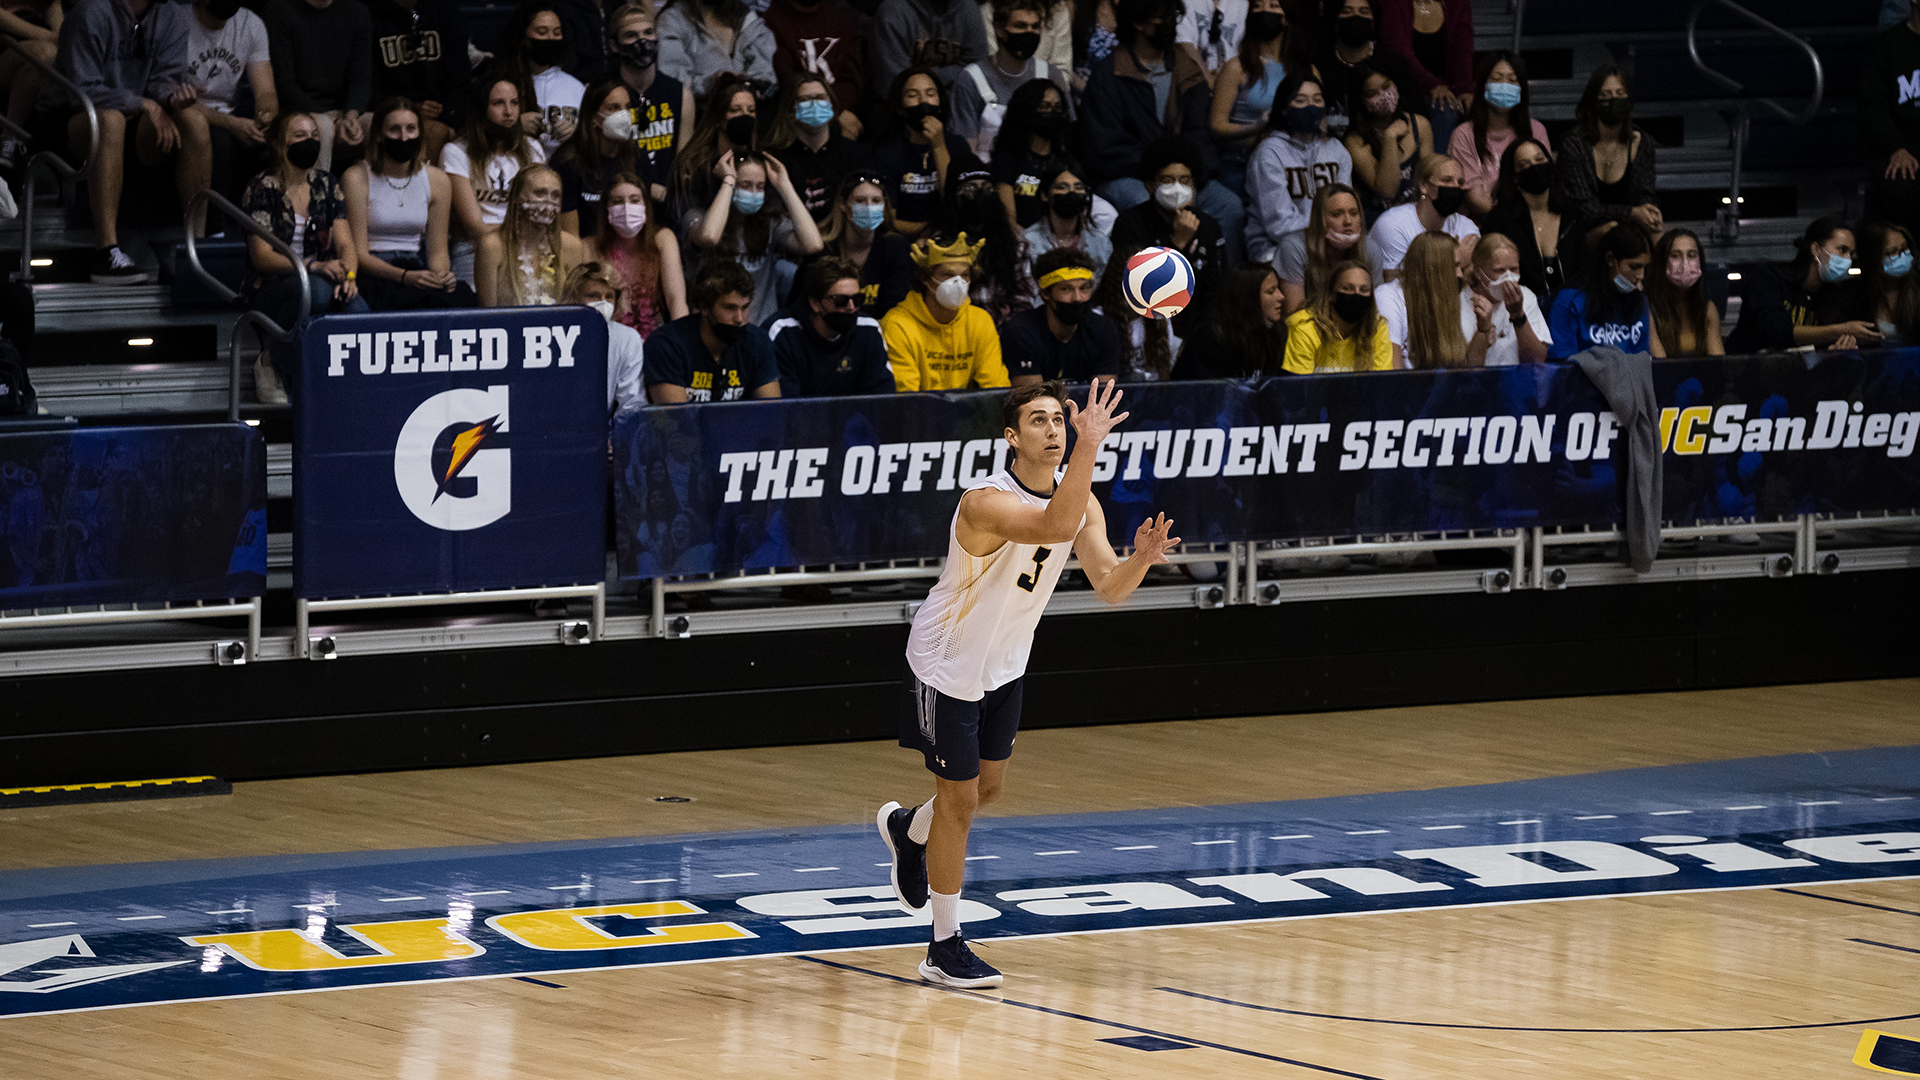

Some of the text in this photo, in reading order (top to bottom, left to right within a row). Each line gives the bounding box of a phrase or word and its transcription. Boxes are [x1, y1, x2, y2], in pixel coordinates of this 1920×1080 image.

[328, 325, 581, 377] FUELED BY
[719, 447, 829, 503] THE
[840, 437, 1012, 495] OFFICI
[1091, 422, 1331, 482] STUDENT
[1339, 414, 1557, 471] SECTION
[1565, 411, 1622, 462] OF
[1016, 545, 1052, 593] 3
